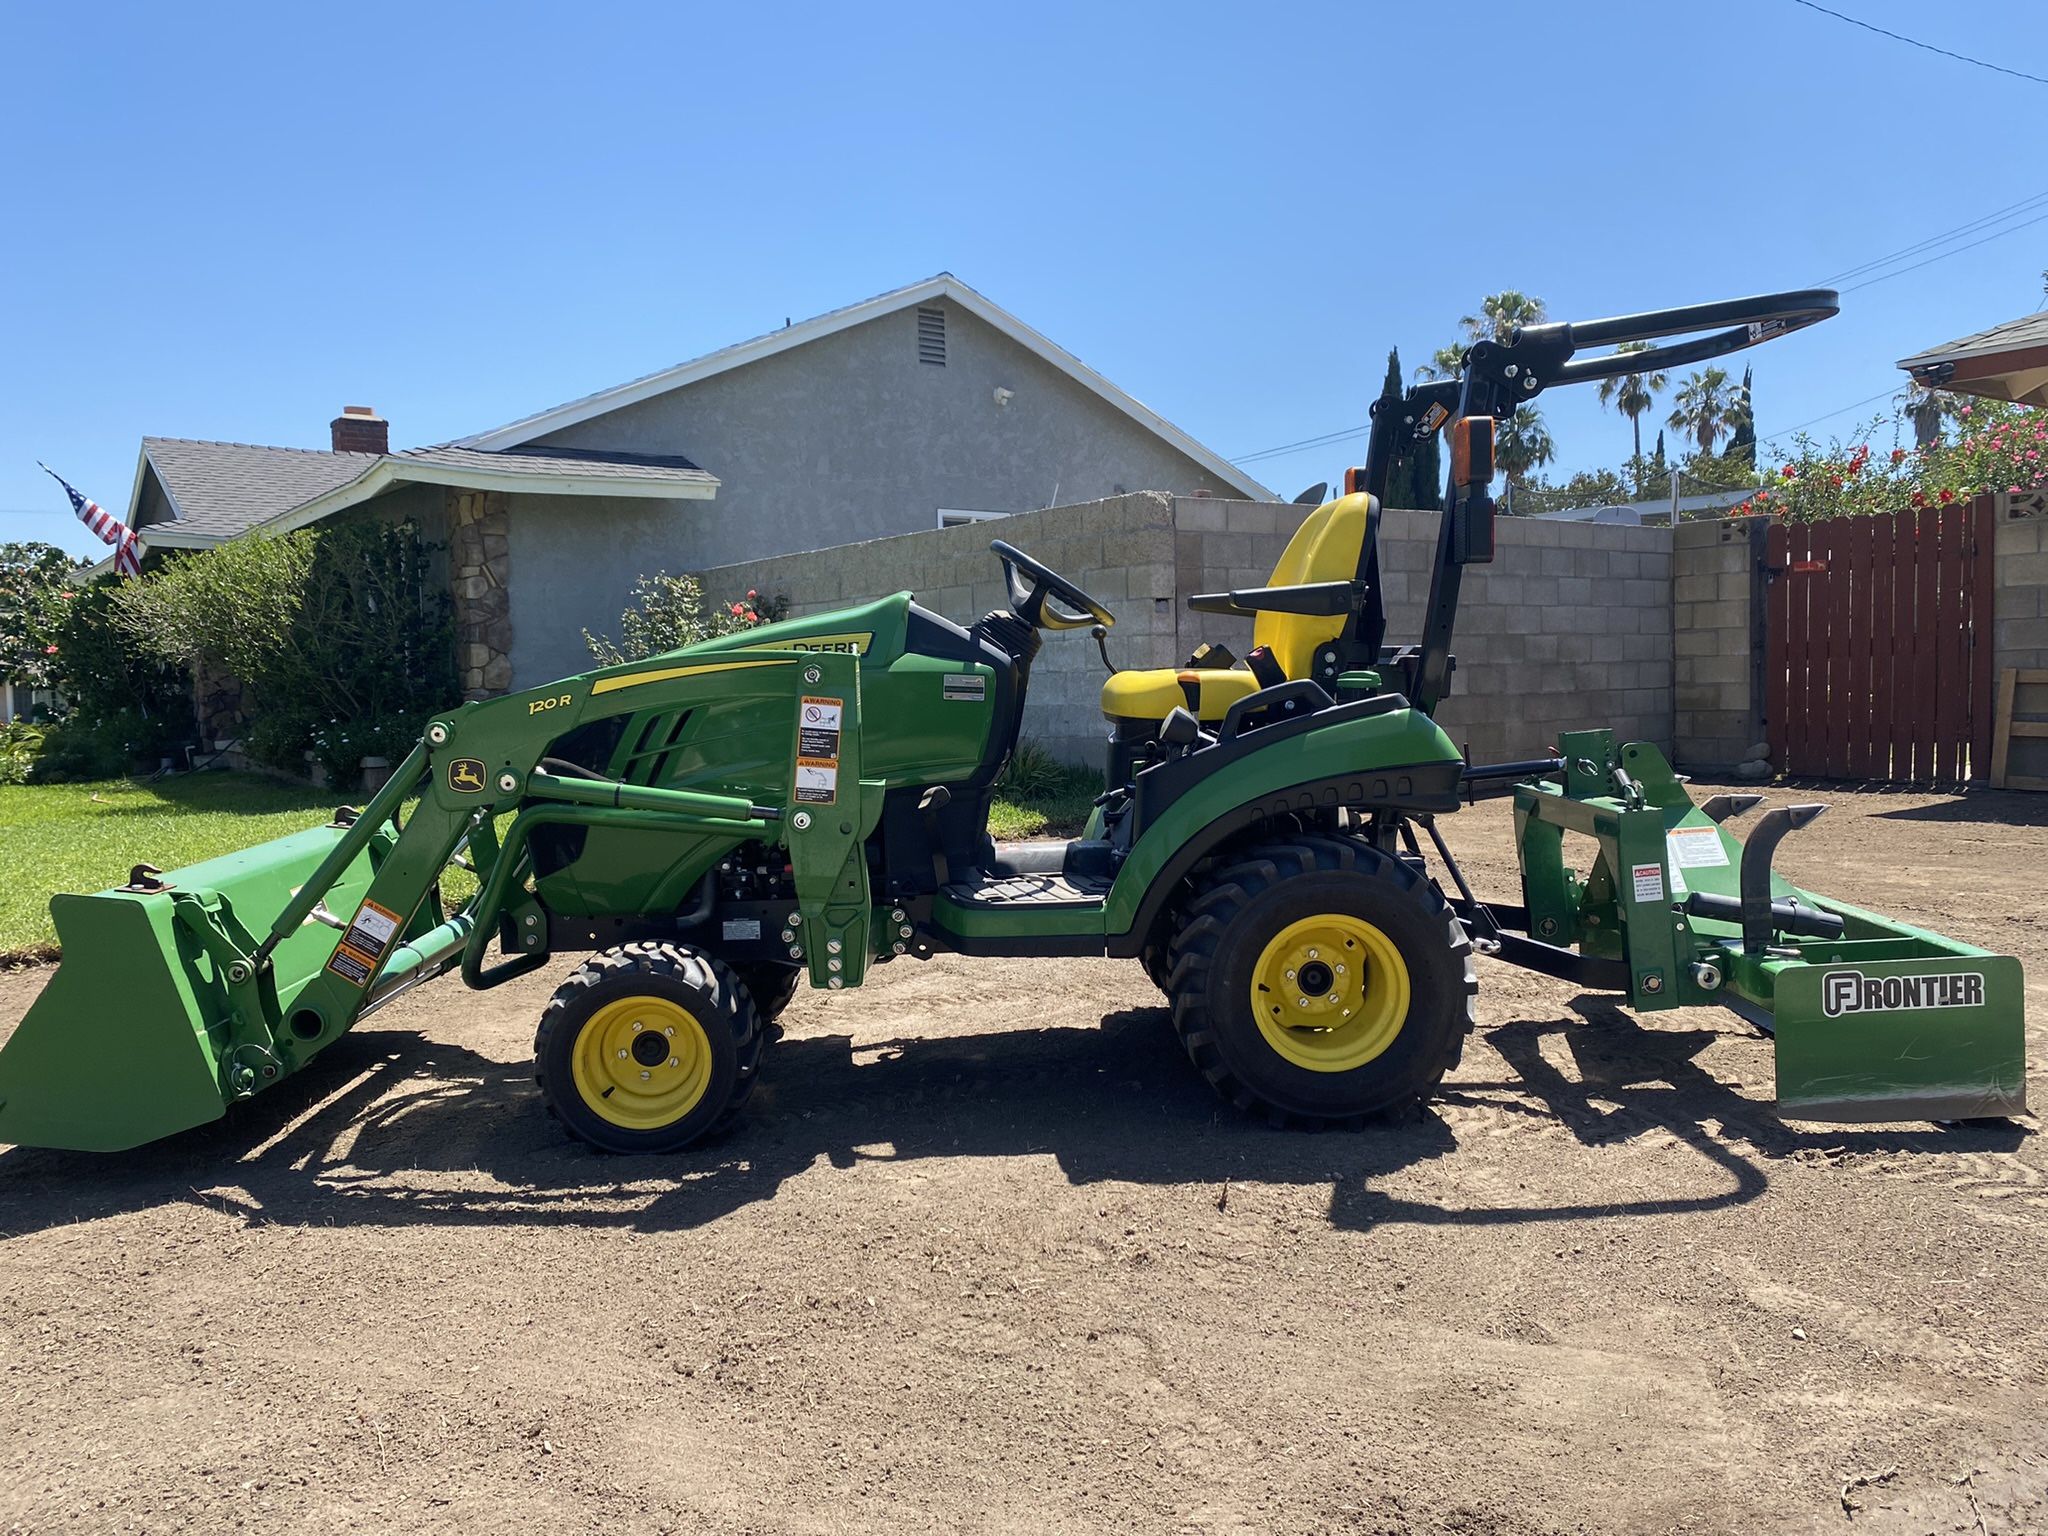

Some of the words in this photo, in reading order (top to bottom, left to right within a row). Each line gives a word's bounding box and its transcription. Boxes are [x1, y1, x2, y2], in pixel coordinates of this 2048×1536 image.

[808, 698, 841, 706] WARNING
[805, 760, 836, 768] WARNING
[1824, 972, 1983, 1016] FRONTIER
